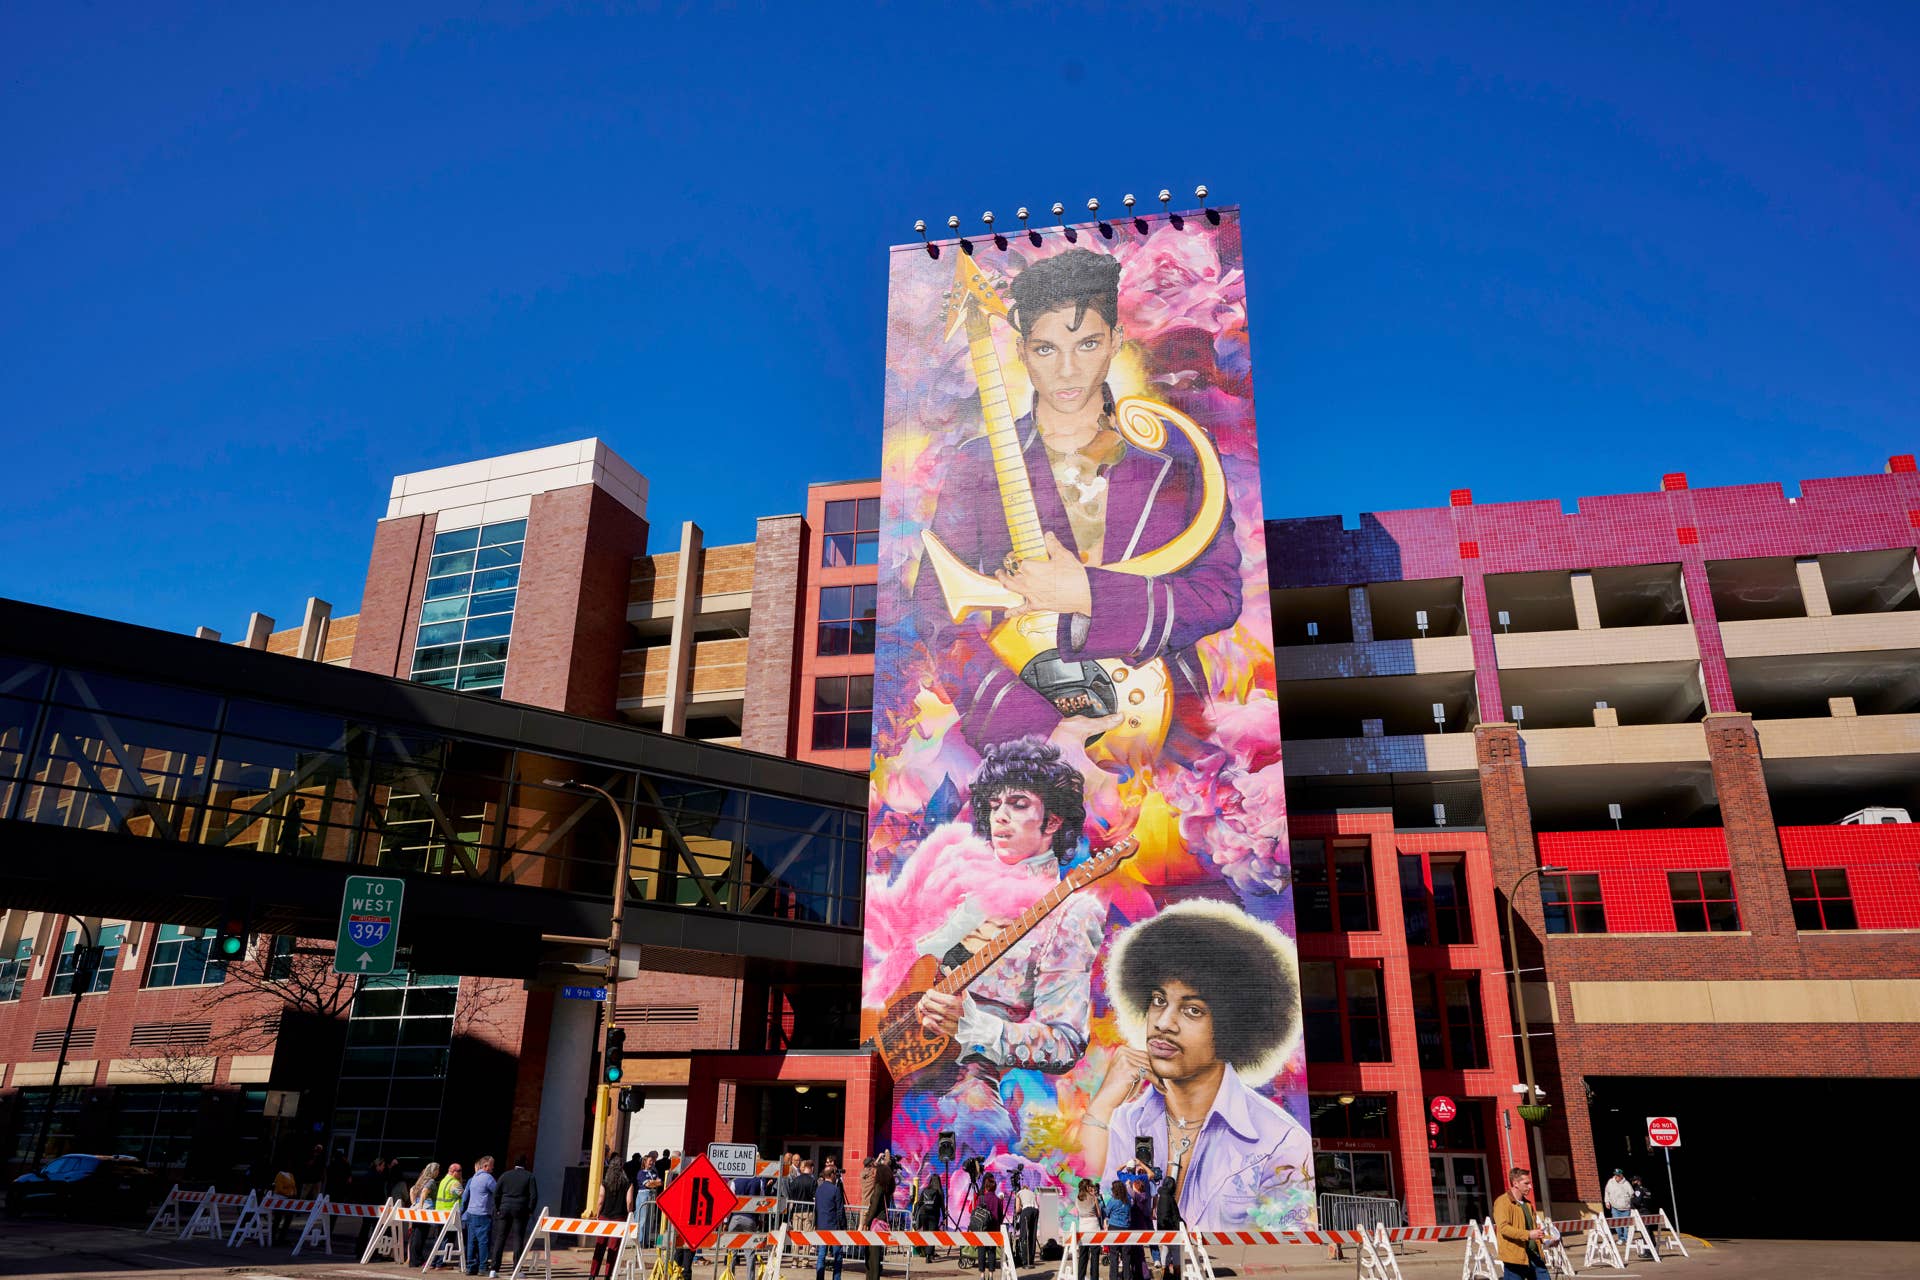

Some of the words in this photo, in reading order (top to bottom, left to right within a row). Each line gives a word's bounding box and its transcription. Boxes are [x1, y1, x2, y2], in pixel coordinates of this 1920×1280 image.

[366, 882, 384, 896] TO
[352, 898, 394, 912] WEST
[354, 924, 384, 940] 394
[565, 988, 571, 996] N
[576, 988, 591, 997] 9th
[596, 990, 604, 998] St
[712, 1149, 729, 1158] BIKE
[734, 1150, 753, 1159] LANE
[717, 1161, 746, 1171] CLOSED
